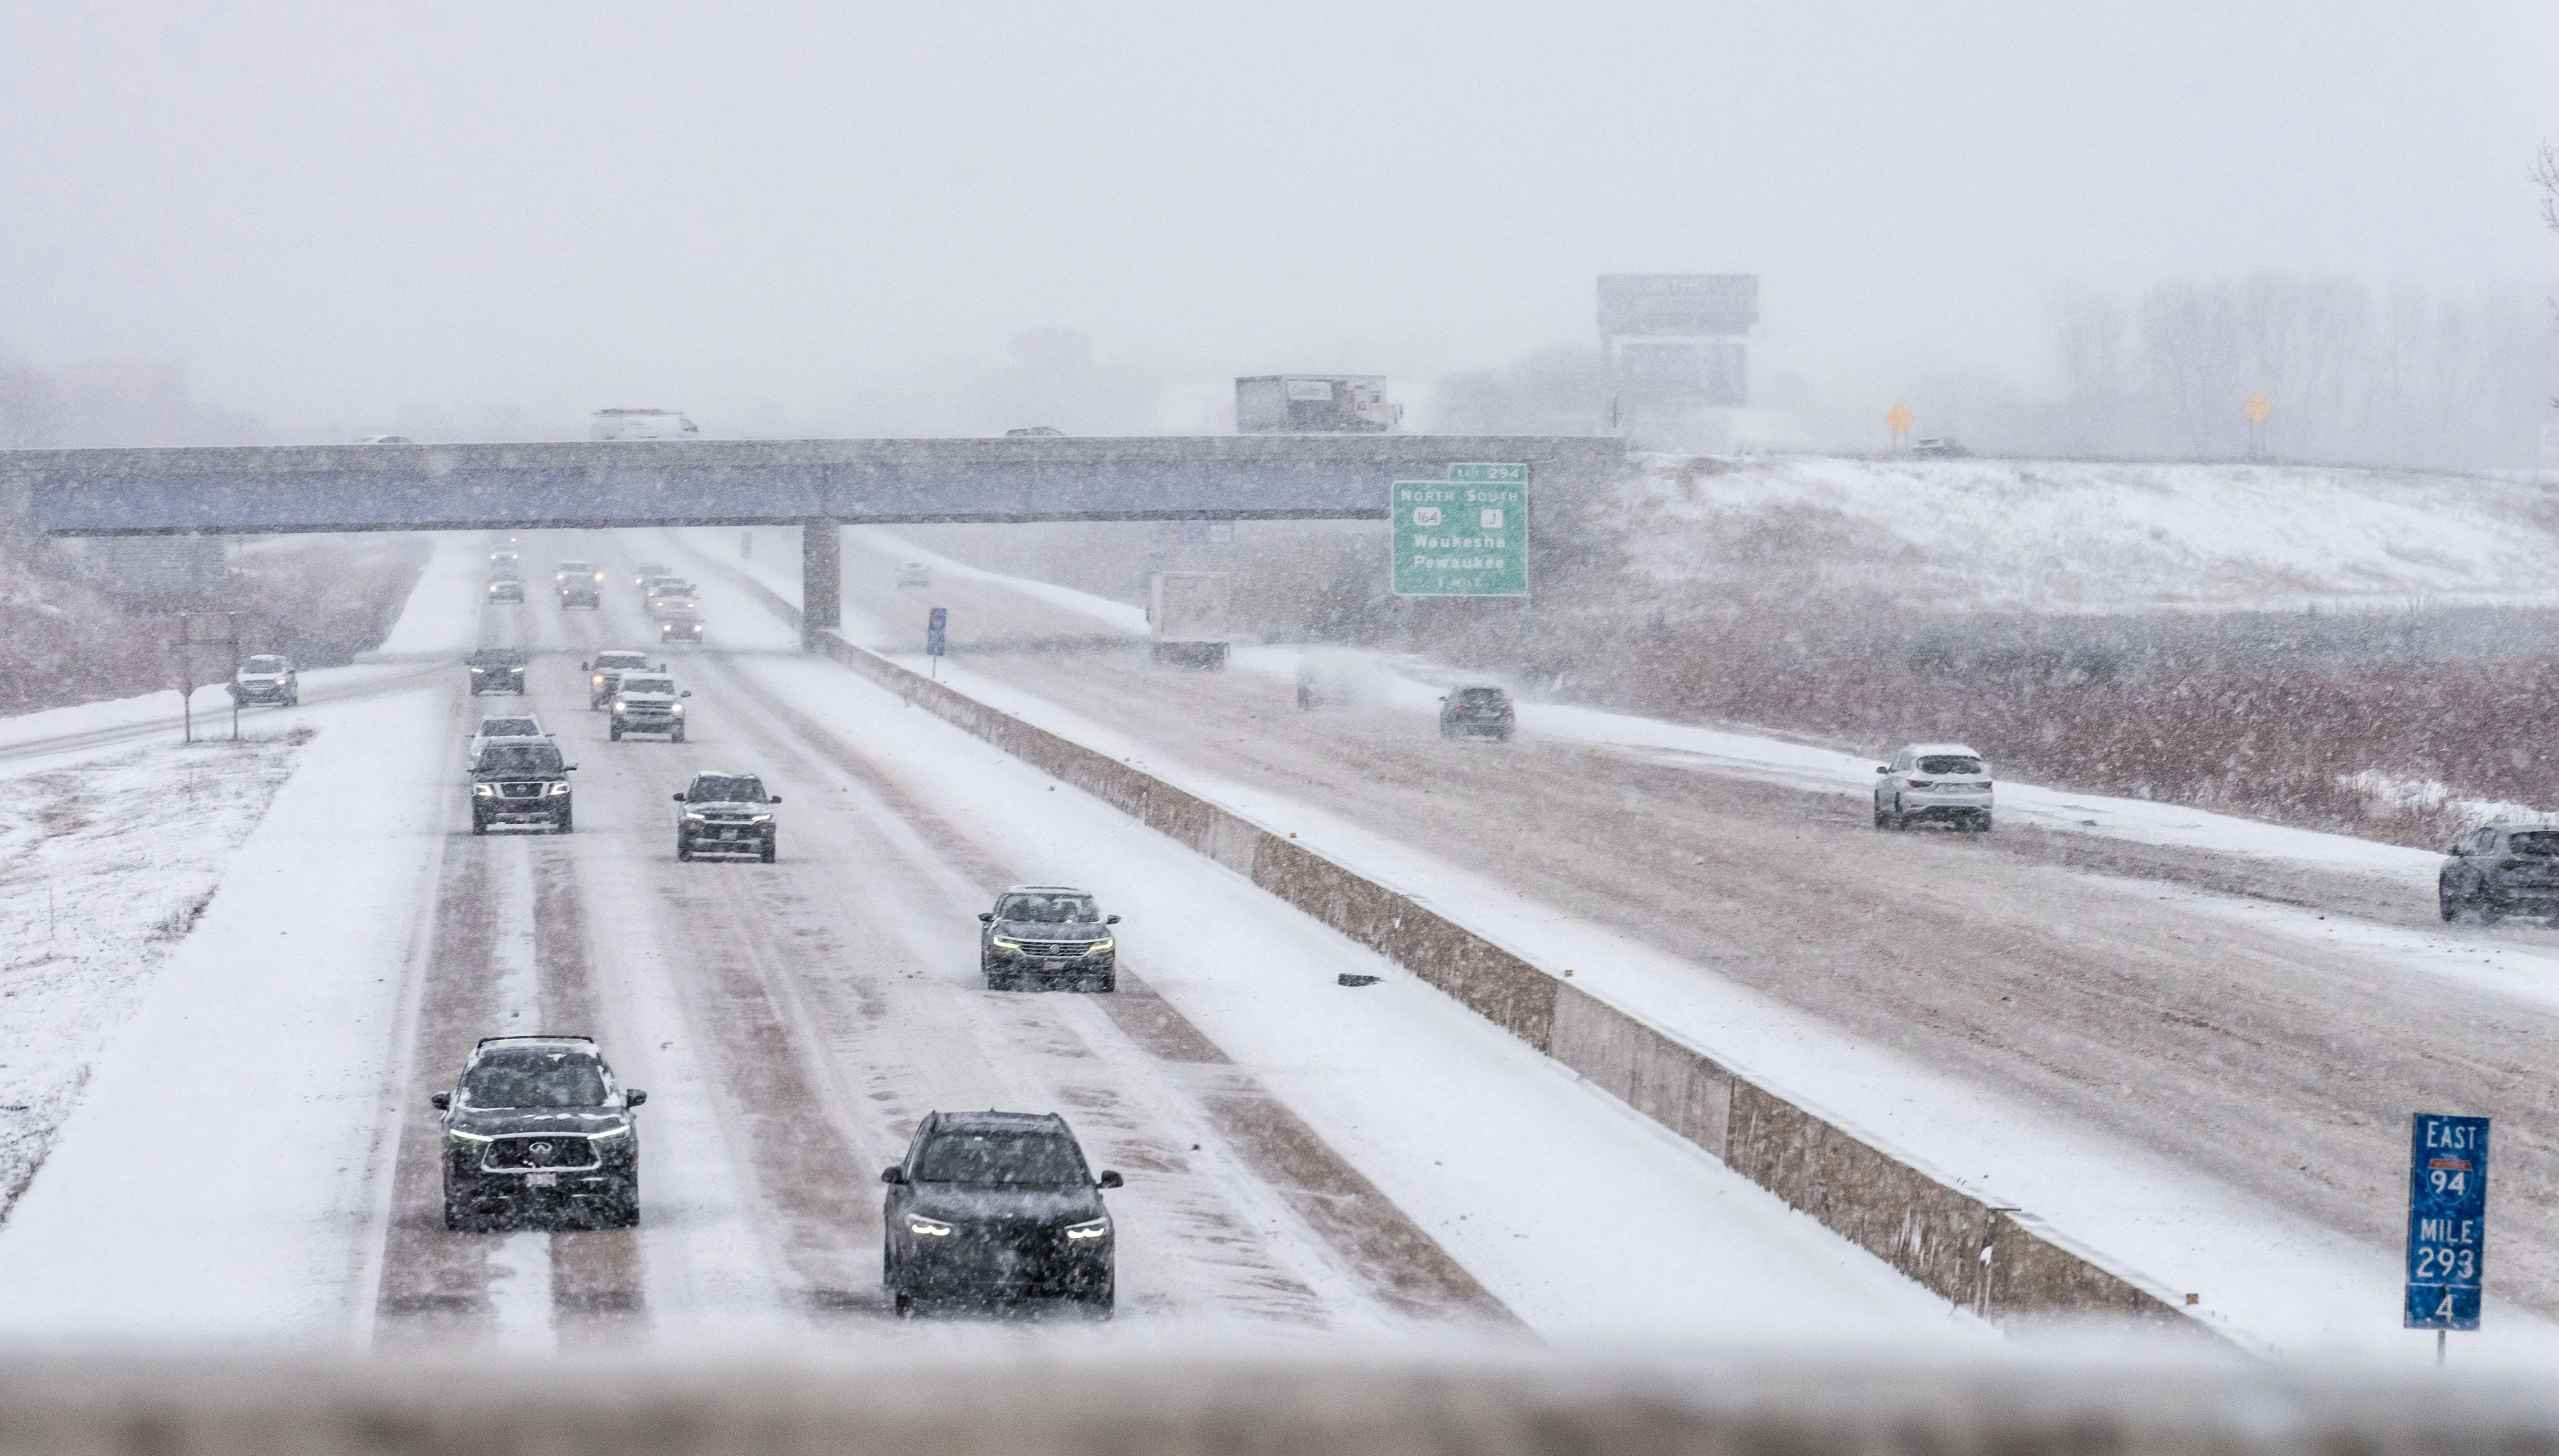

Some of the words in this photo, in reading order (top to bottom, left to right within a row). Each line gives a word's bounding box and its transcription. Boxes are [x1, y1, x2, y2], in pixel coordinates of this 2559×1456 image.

[1489, 468, 1519, 478] 294
[1401, 489, 1454, 502] NORTH
[1466, 489, 1518, 502] SOUTH
[1417, 511, 1438, 524] 164
[1489, 512, 1496, 524] J
[1414, 535, 1506, 548] Waukesha
[1414, 555, 1505, 569] Pewaukee
[2426, 1121, 2476, 1150] EAST
[2430, 1170, 2465, 1196] 94
[2421, 1218, 2474, 1244] MILE
[2416, 1246, 2474, 1279] 293
[2435, 1293, 2453, 1325] 4
